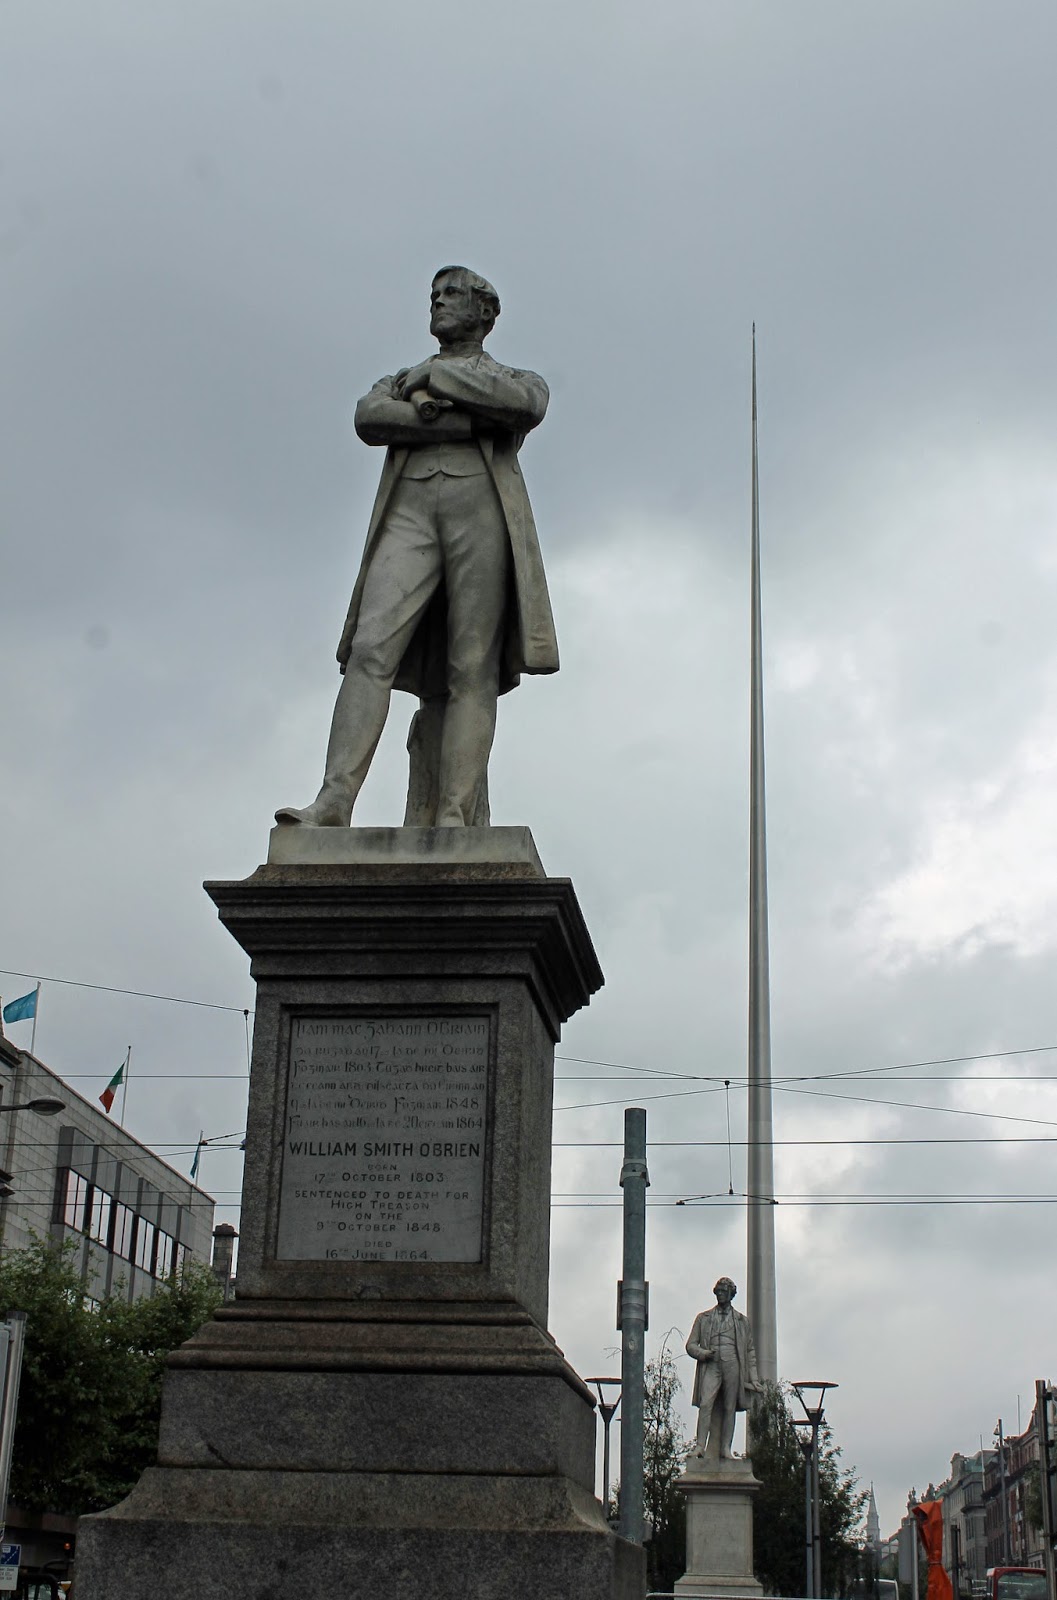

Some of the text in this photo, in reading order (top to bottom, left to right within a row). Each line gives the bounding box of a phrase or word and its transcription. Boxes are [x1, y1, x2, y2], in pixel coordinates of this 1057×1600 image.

[289, 1142, 357, 1157] WILLIAM
[363, 1142, 413, 1157] SMITH
[367, 1163, 397, 1171] BORN
[295, 1190, 469, 1200] SENTENCED TO DEATH FOR
[355, 1212, 372, 1220] ON
[365, 1240, 393, 1248] DIED
[352, 1249, 386, 1260] JUNE
